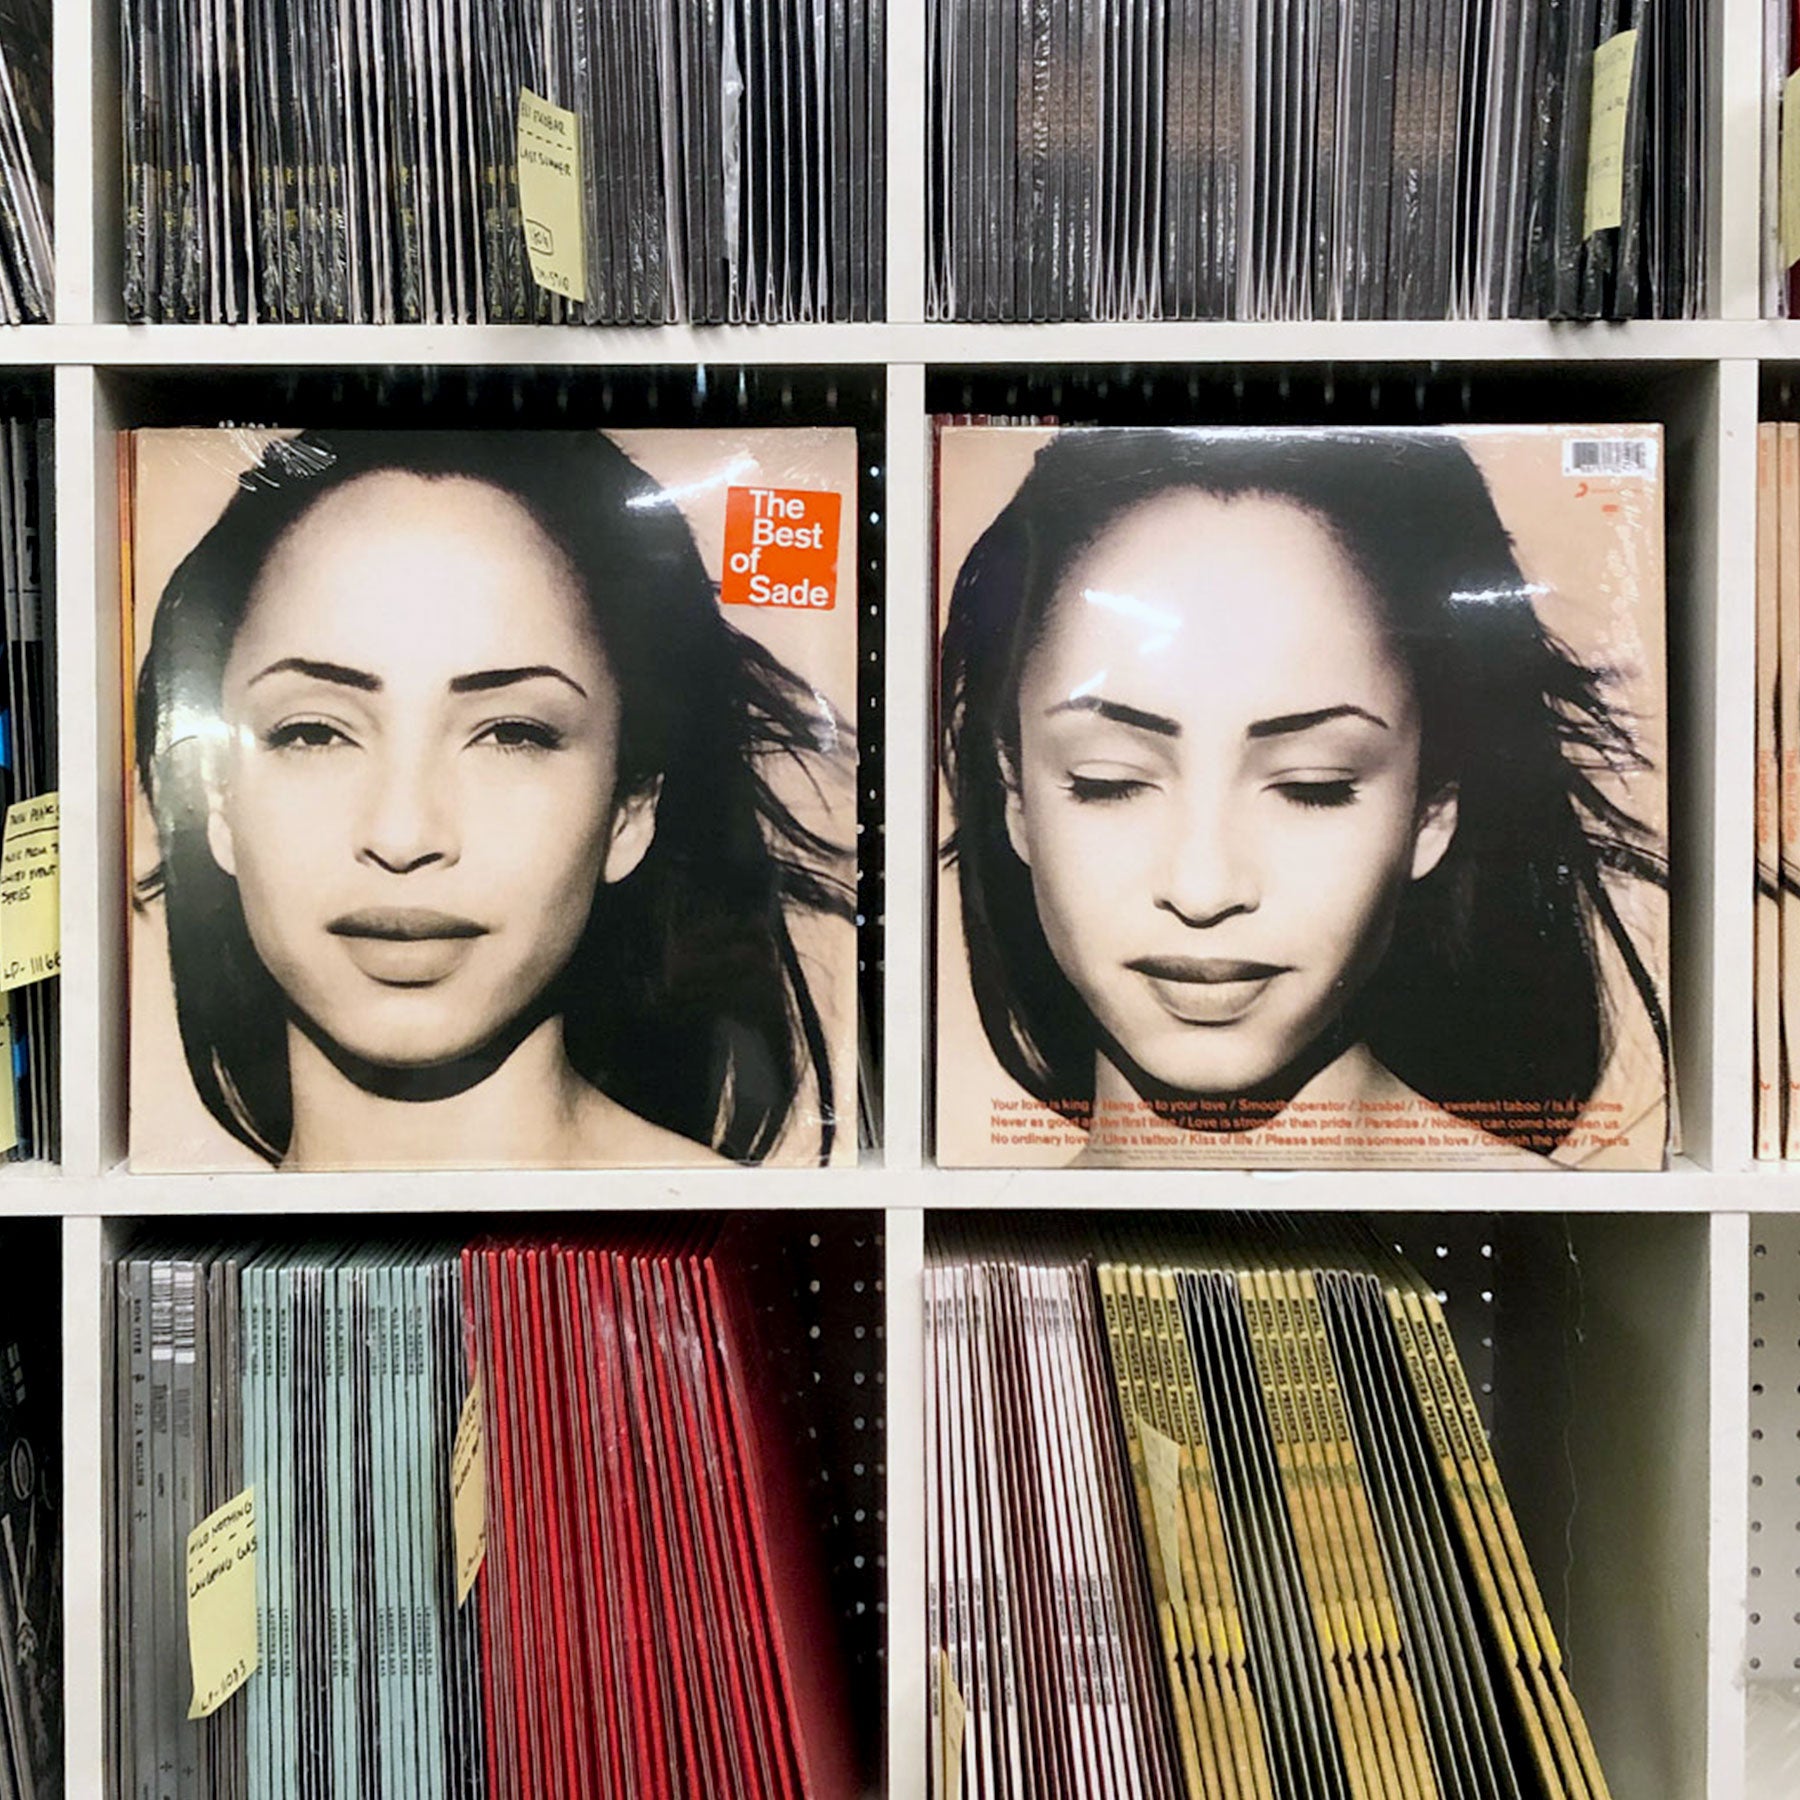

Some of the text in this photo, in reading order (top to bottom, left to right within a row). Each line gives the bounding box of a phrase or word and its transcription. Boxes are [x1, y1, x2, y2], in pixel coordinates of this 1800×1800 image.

[730, 547, 762, 574] of
[749, 489, 805, 519] The
[753, 518, 823, 549] Best
[748, 575, 829, 606] Sade
[991, 1117, 1026, 1128] Never
[1188, 1118, 1217, 1128] Love
[1290, 1118, 1317, 1128] than
[1320, 1118, 1351, 1130] pride
[1483, 1121, 1505, 1129] can
[1507, 1121, 1544, 1129] come
[1604, 1121, 1619, 1129] us
[991, 1134, 1009, 1144] No
[1011, 1134, 1061, 1146] ordinary
[1190, 1135, 1216, 1145] Kiss
[1311, 1136, 1341, 1146] send
[1344, 1138, 1365, 1146] me
[1428, 1136, 1441, 1146] to
[1443, 1136, 1469, 1146] love
[1022, 1100, 1047, 1110] love
[1155, 1101, 1168, 1111] to
[1170, 1101, 1198, 1113] your
[1200, 1101, 1226, 1111] love
[1105, 1294, 1137, 1440] METAL FINGERS PRESENTS
[1120, 1294, 1133, 1329] METAL
[1127, 1333, 1143, 1380] FINGERS
[1136, 1296, 1150, 1331] METAL
[1144, 1335, 1159, 1383] FINGERS
[1152, 1298, 1186, 1446] METAL FINGERS PRESENTS
[1168, 1299, 1203, 1446] METAL FINGERS PRESENTS
[1245, 1299, 1285, 1444] METAL FINGERS PRESENTS
[1261, 1299, 1301, 1444] METAL FINGERS PRESENTS
[1277, 1299, 1316, 1442] METAL FINGERS PRESENTS
[1292, 1298, 1332, 1443] METAL FINGERS PRESENTS
[1308, 1298, 1348, 1442] METAL FINGERS PRESENTS
[1396, 1316, 1449, 1459] METAL FINGERS PRESENTS
[1415, 1320, 1470, 1461] METAL FINGERS PRESENTS
[1435, 1321, 1489, 1462] METAL FINGERS PRESENTS
